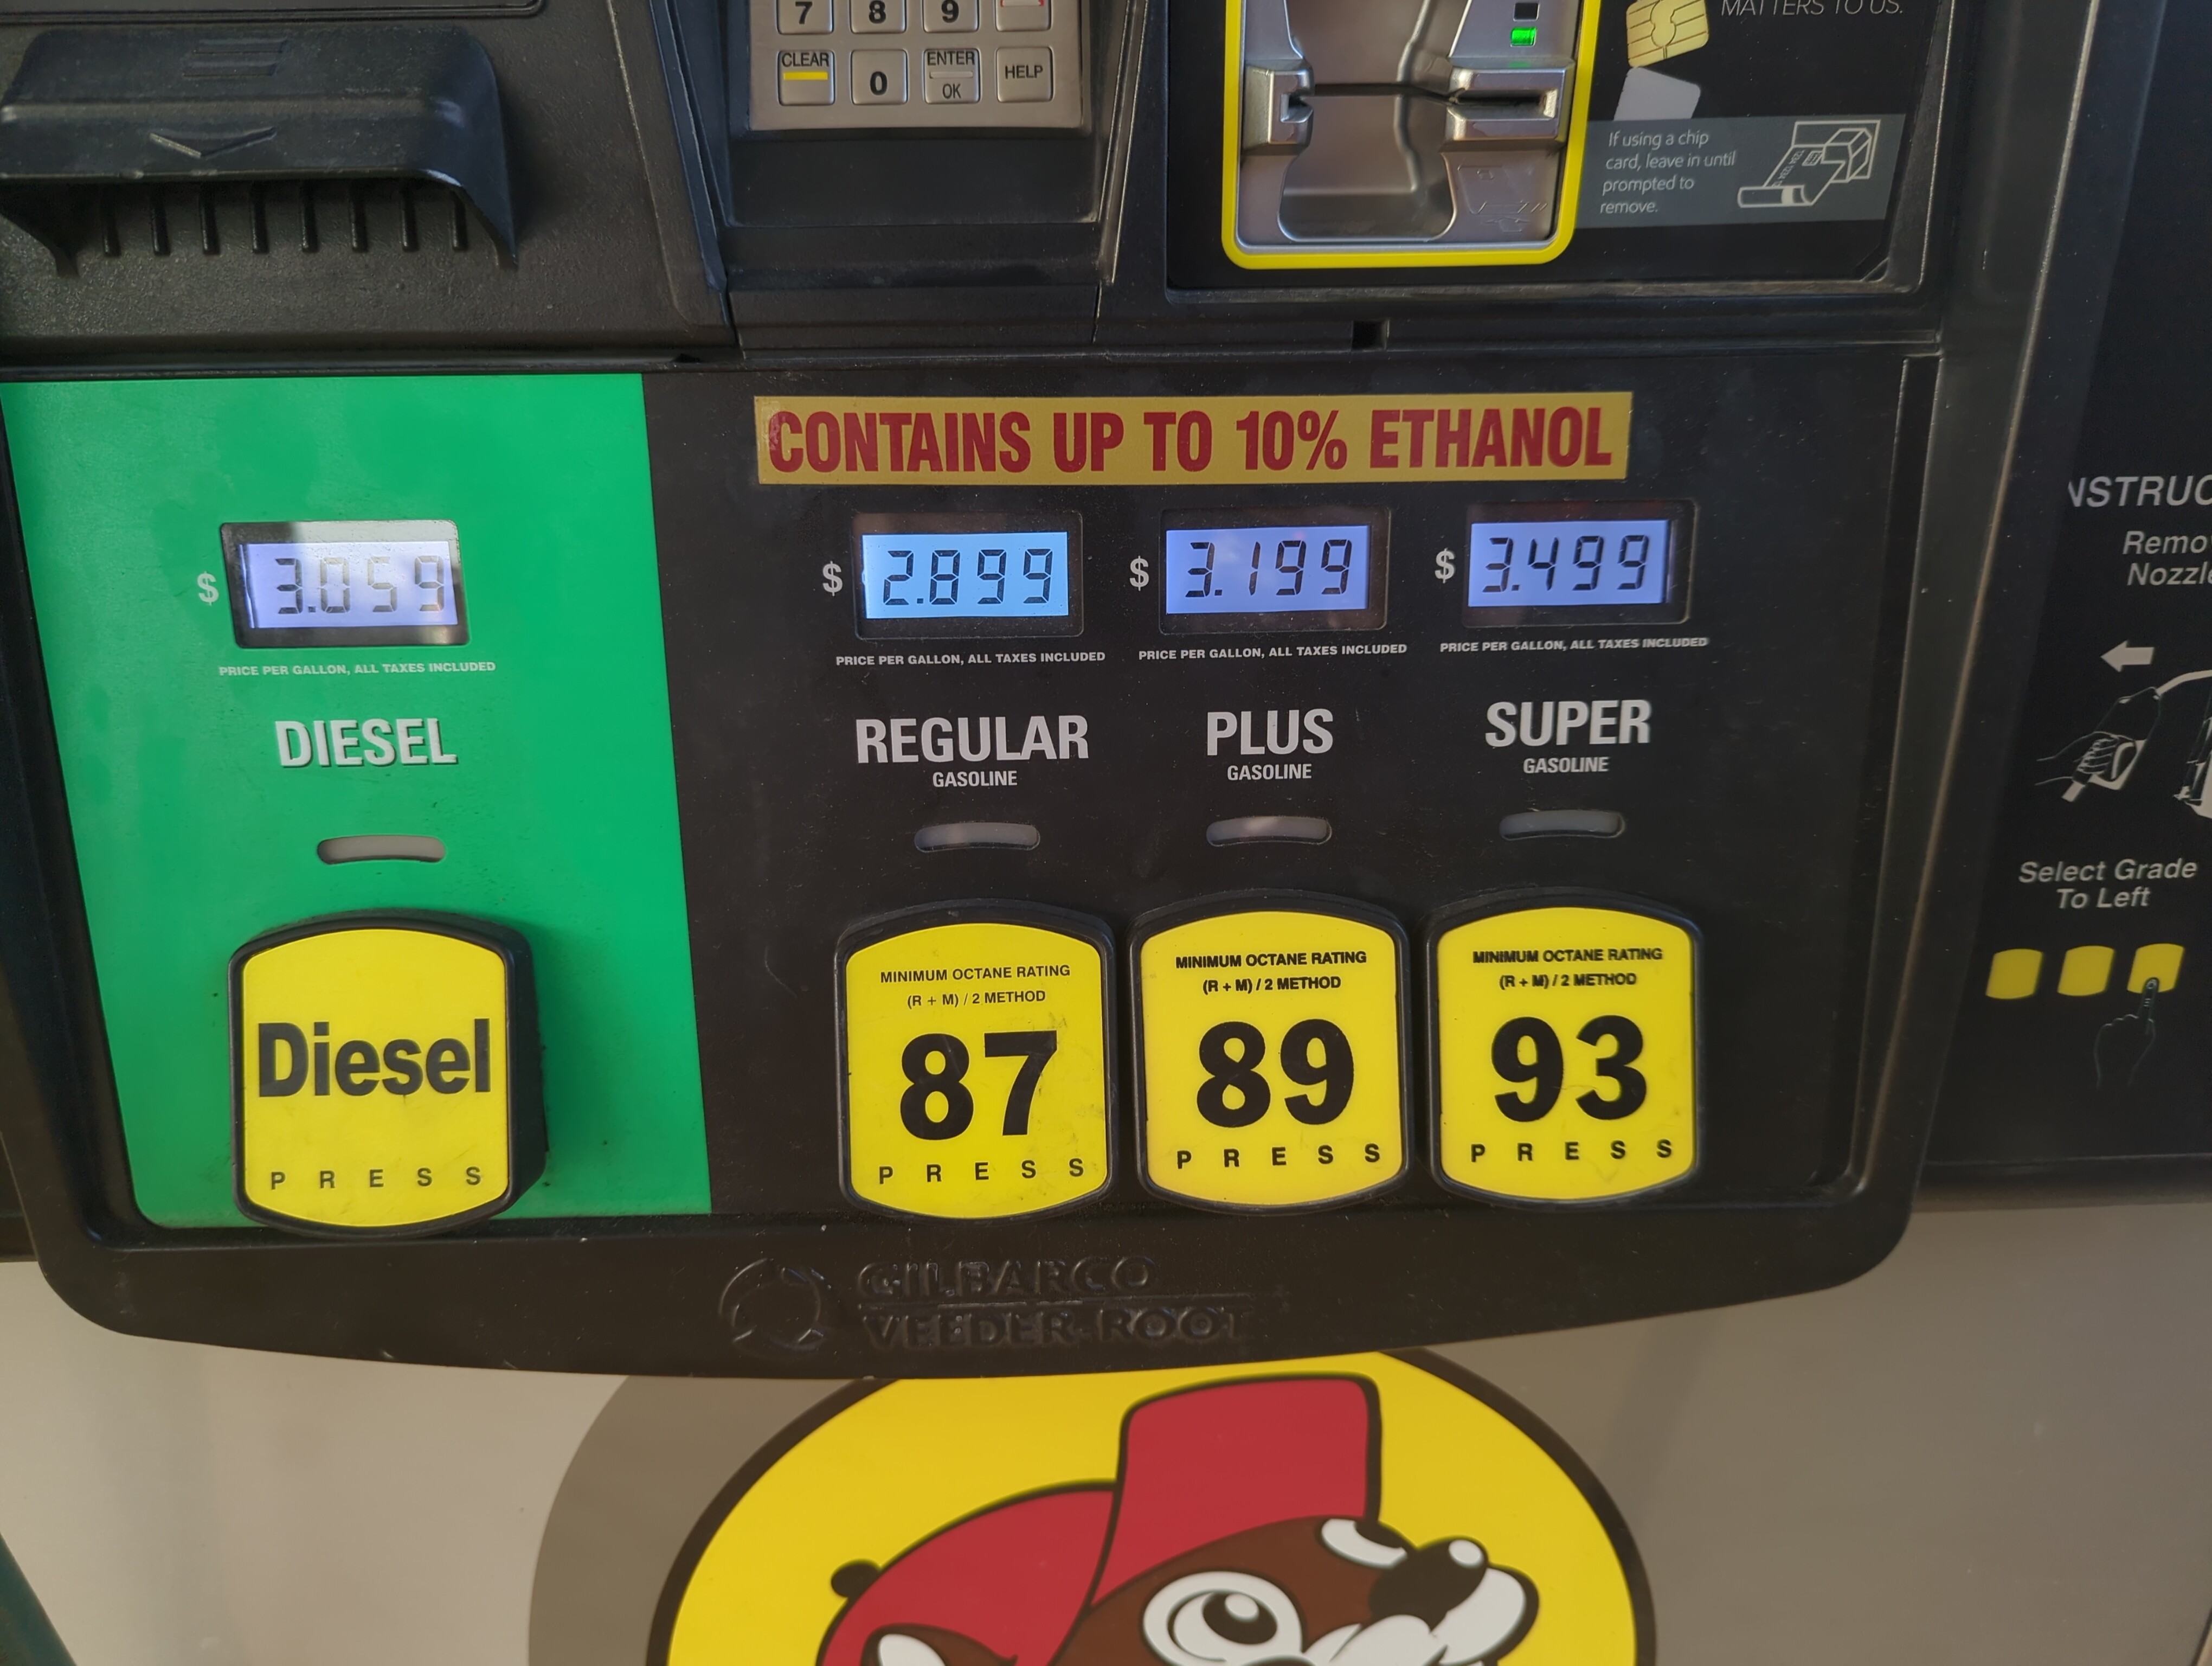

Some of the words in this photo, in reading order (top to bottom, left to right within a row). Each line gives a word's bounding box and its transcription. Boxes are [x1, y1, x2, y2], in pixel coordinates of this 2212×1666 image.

[795, 1, 813, 24] 7
[869, 0, 886, 24] 8
[941, 0, 960, 23] 9
[1721, 0, 1824, 16] MATTERS
[1834, 0, 1863, 14] TO
[1870, 0, 1903, 14] US.
[782, 53, 829, 67] CLEAR
[927, 50, 975, 66] ENTER
[870, 71, 888, 95] 0
[1005, 65, 1044, 79] HELP
[942, 83, 962, 99] OK
[1609, 130, 1621, 147] If
[1622, 131, 1662, 150] using
[1666, 134, 1674, 145] a
[1678, 129, 1709, 149] chip
[1605, 153, 1642, 171] card,
[1645, 153, 1683, 169] leave
[1687, 153, 1700, 167] in
[1704, 150, 1736, 166] until
[1602, 174, 1677, 196] prompted
[1680, 176, 1695, 190] to
[1600, 201, 1658, 214] remove.
[768, 411, 1031, 473] CONTAINS
[1054, 411, 1127, 472] UP
[1143, 410, 1213, 471] TO
[1236, 409, 1348, 470] 10%
[1369, 406, 1612, 469] ETHANOL
[2123, 530, 2212, 554] Remo
[1129, 555, 1149, 591] $
[1185, 539, 1352, 598] 3.199
[1435, 548, 1456, 584] $
[1482, 534, 1650, 593] 3.499
[197, 571, 219, 606] $
[275, 555, 445, 614] 3.059
[822, 561, 844, 597] $
[883, 548, 1053, 606] 2.899
[1139, 651, 1176, 660] PRICE
[1181, 650, 1206, 659] PER
[1210, 648, 1265, 659] GALLON,
[1269, 648, 1293, 657] ALL
[1296, 646, 1338, 656] TAXES
[1341, 644, 1407, 655] INCLUDED
[1440, 643, 1478, 652] PRICE
[1482, 642, 1507, 651] PER
[1511, 640, 1567, 651] GALLON,
[1570, 640, 1594, 650] ALL
[1598, 638, 1639, 649] TAXES
[1642, 637, 1709, 648] INCLUDED
[219, 666, 259, 676] PRICE
[263, 665, 289, 675] PER
[293, 665, 351, 675] GALLON,
[355, 664, 379, 674] ALL
[382, 663, 425, 673] TAXES
[429, 662, 496, 672] INCLUDED
[836, 656, 875, 665] PRICE
[879, 655, 904, 665] PER
[908, 655, 964, 665] GALLON,
[968, 654, 992, 664] ALL
[995, 653, 1037, 663] TAXES
[1040, 652, 1105, 662] INCLUDED
[1207, 708, 1334, 756] PLUS
[1485, 699, 1652, 747] SUPER
[275, 717, 458, 768] DIESEL
[856, 715, 1089, 764] REGULAR
[1227, 764, 1313, 780] GASOLINE
[1523, 757, 1610, 774] GASOLINE
[933, 771, 1018, 787] GASOLINE
[2018, 861, 2106, 883] Select
[2114, 858, 2198, 881] Grade
[2056, 888, 2088, 909] To
[2096, 886, 2151, 908] Left
[1175, 954, 1242, 969] MINIMUM
[1245, 953, 1307, 966] OCTANE
[1311, 951, 1367, 964] RATING
[1473, 950, 1539, 963] MINIMUM
[1543, 949, 1603, 962] OCTANE
[1607, 947, 1663, 960] RATING
[880, 969, 948, 983] MINIMUM
[952, 966, 1012, 980] OCTANE
[1017, 964, 1071, 978] RATING
[1277, 976, 1341, 990] METHOD
[1573, 972, 1636, 986] METHOD
[985, 990, 1046, 1003] METHOD
[258, 1018, 491, 1097] Diesel
[1491, 1015, 1647, 1122] 93
[1197, 1018, 1354, 1128] 89
[900, 1030, 1058, 1140] 87
[858, 1256, 1156, 1300] GILBARCO
